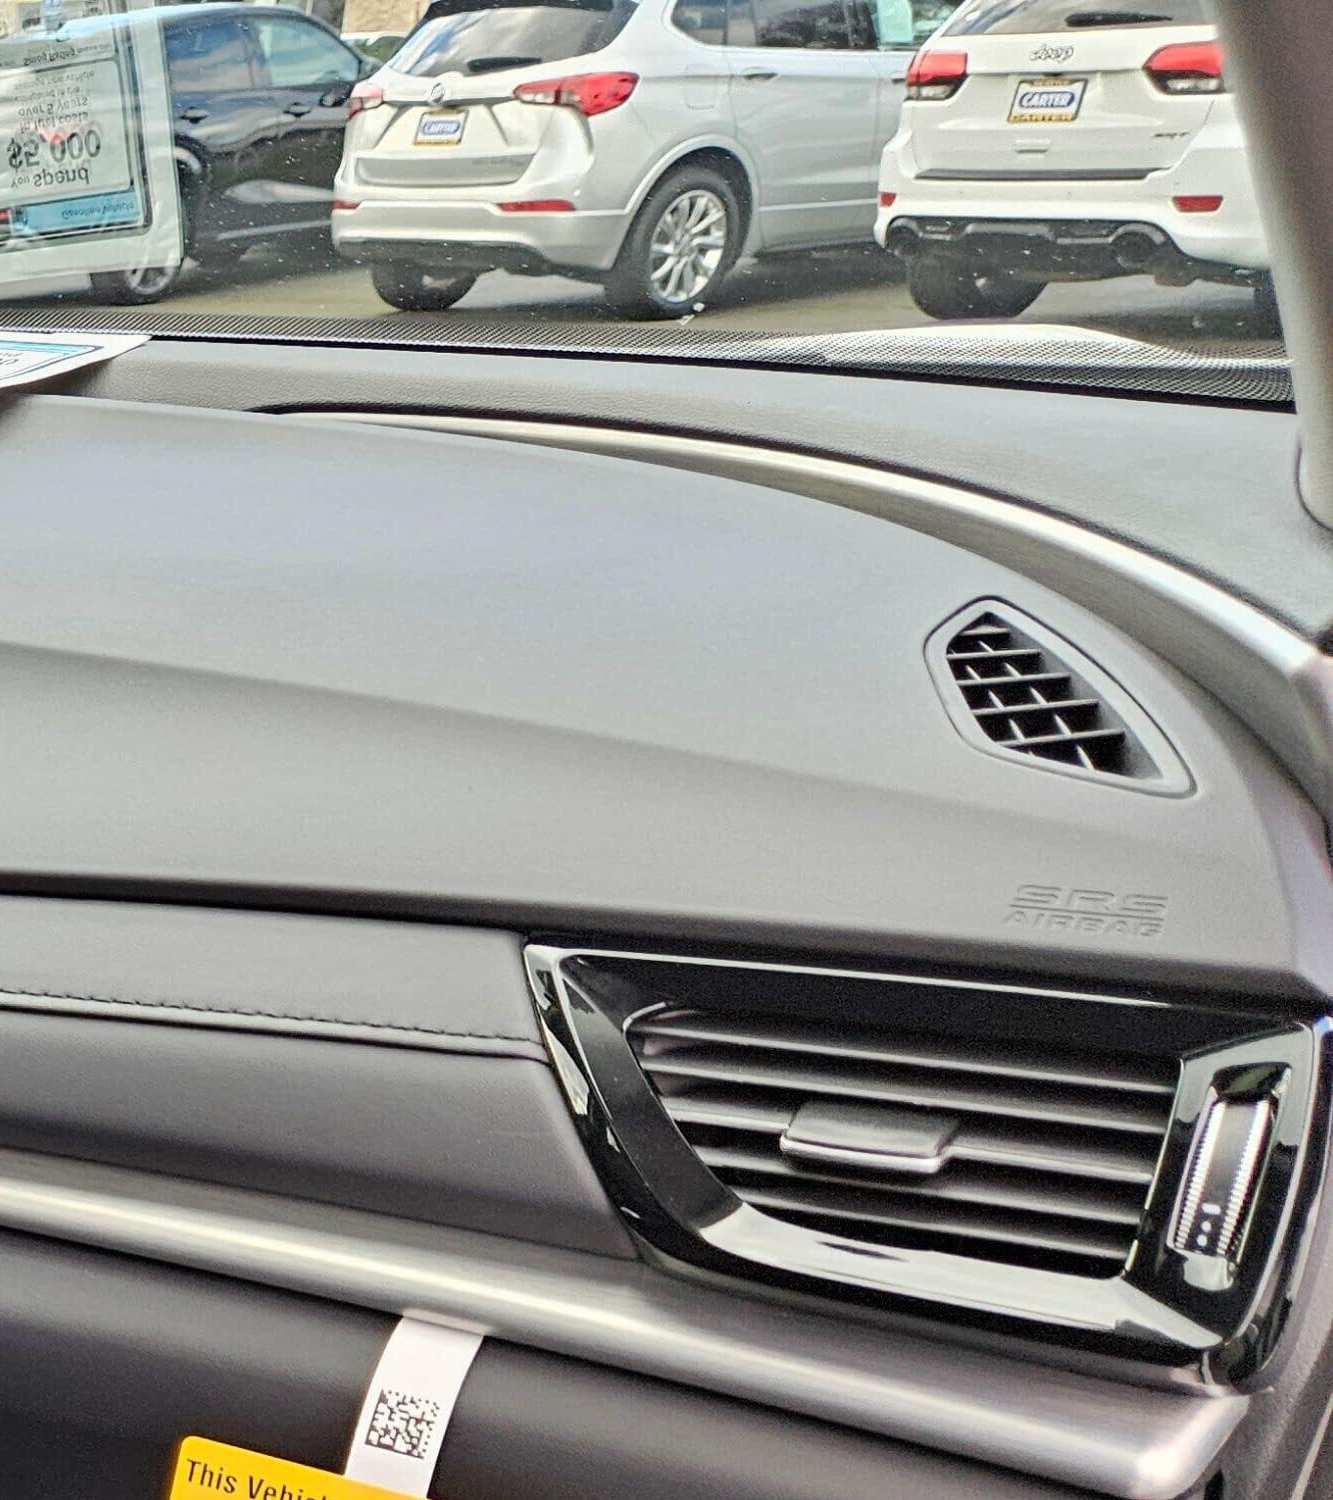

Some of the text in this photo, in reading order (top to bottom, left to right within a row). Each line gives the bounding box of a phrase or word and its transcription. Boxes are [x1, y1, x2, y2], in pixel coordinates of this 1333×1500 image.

[1020, 92, 1072, 107] CARTER
[1013, 883, 1169, 914] SRS
[999, 909, 1166, 938] AIRBAG
[187, 1458, 237, 1494] This
